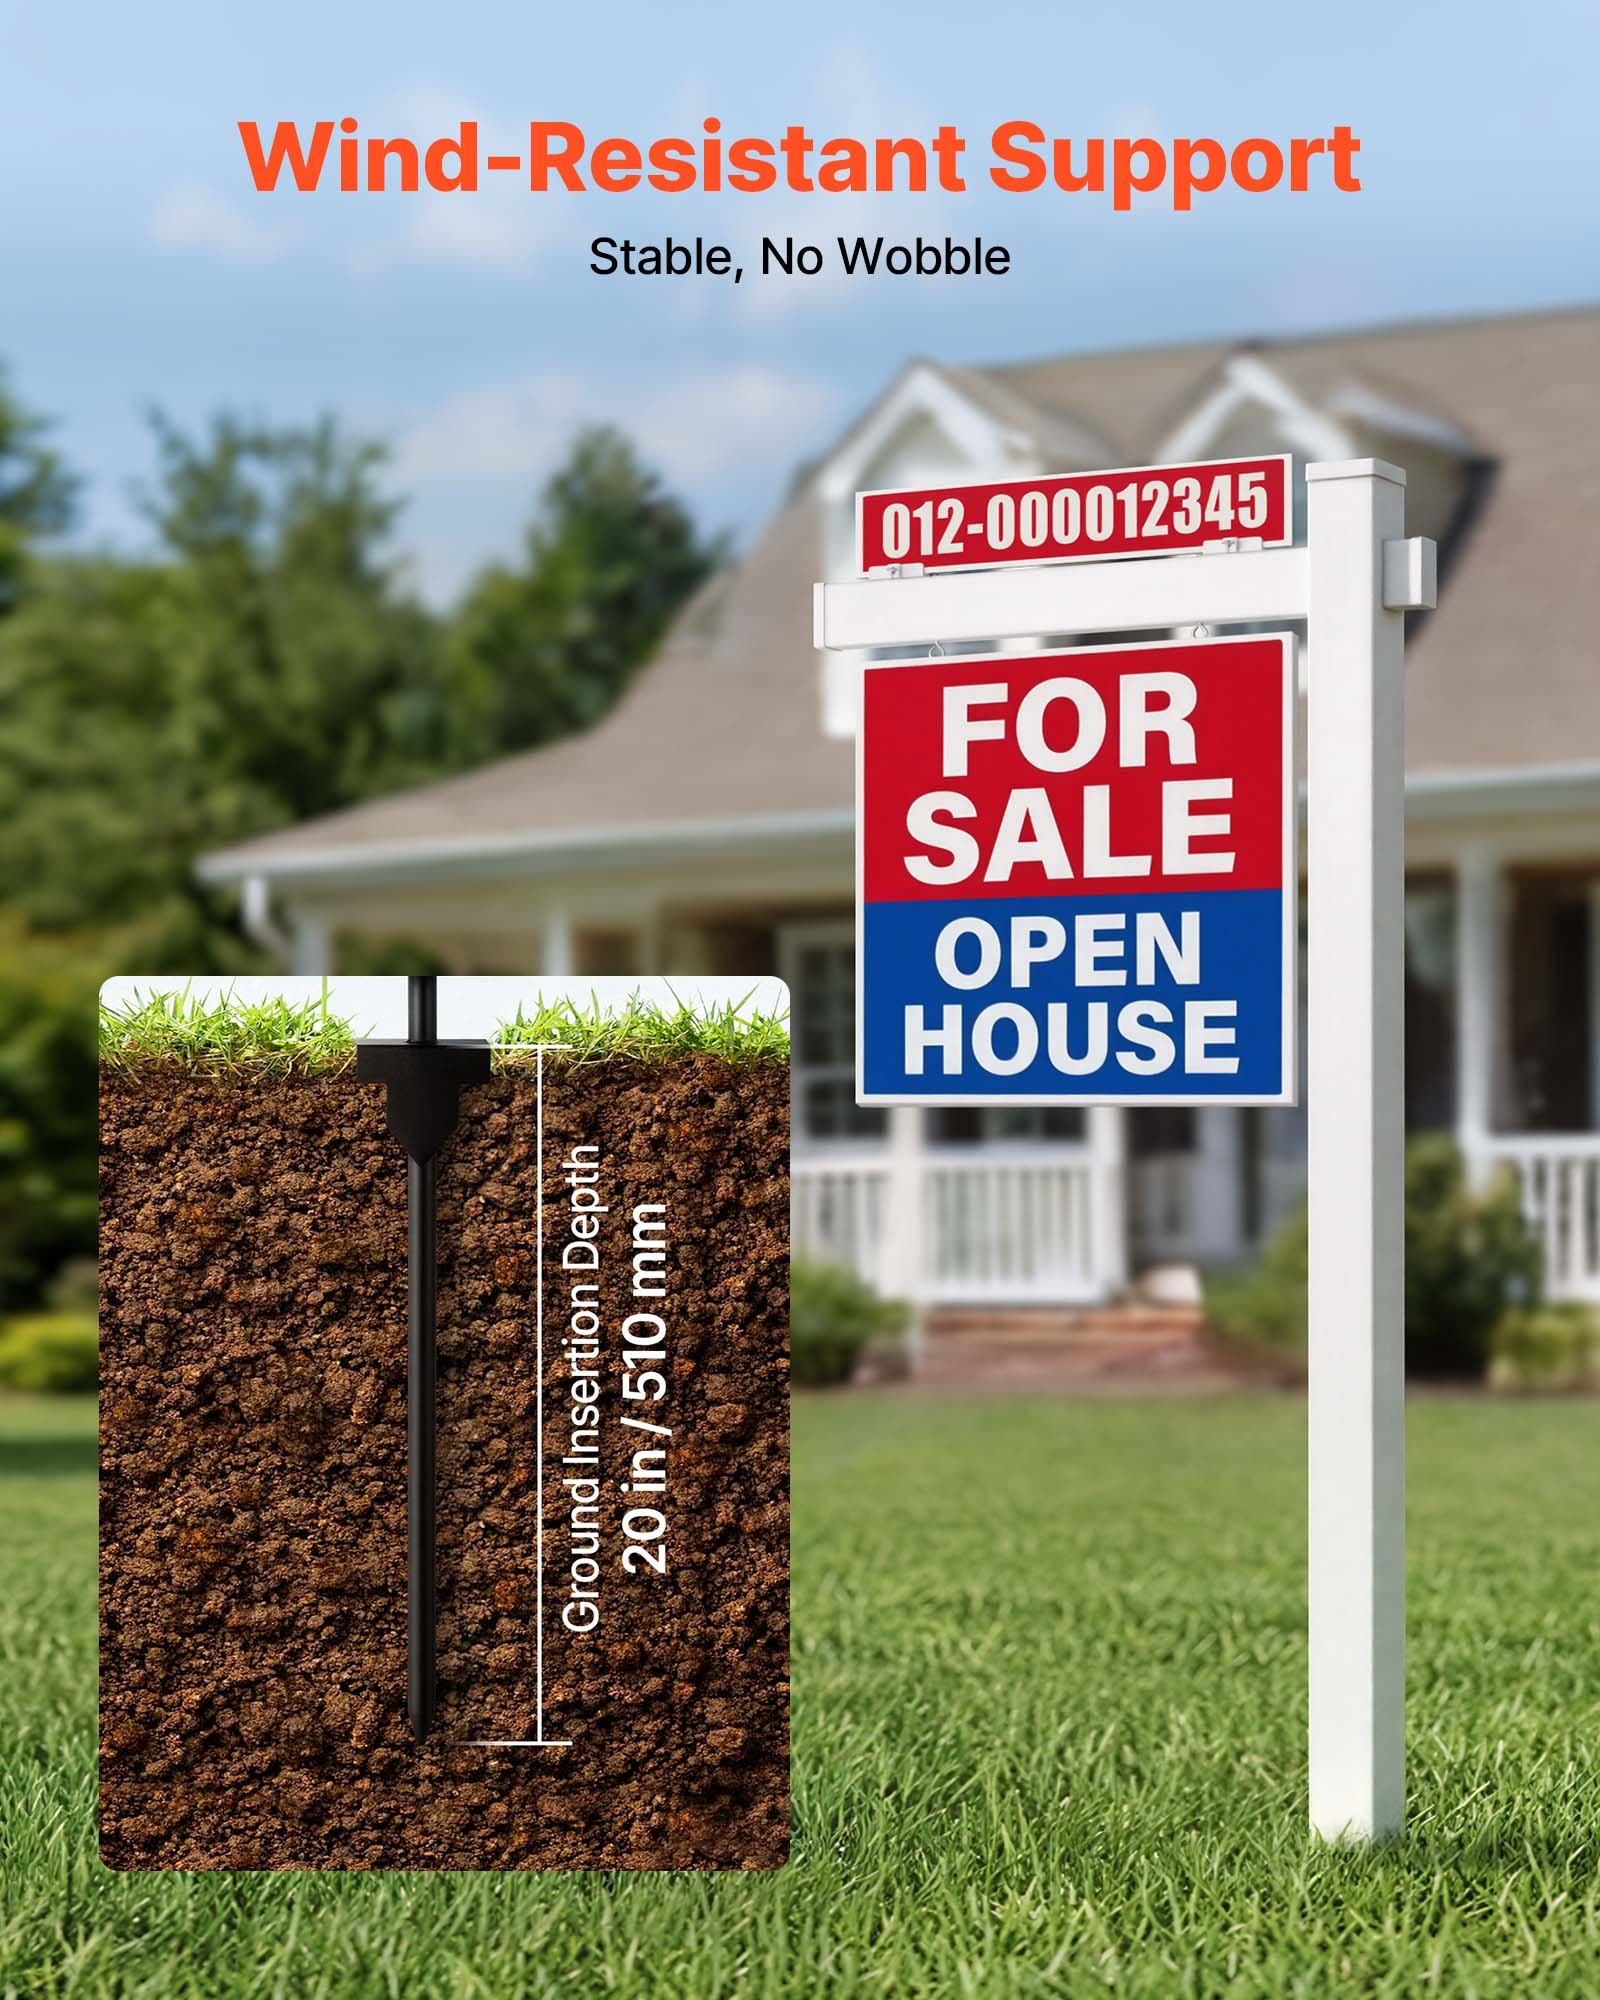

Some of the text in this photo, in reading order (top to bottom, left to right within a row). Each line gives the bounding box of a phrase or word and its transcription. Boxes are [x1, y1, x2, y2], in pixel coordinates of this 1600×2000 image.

[882, 471, 1268, 559] 012-000012345
[943, 672, 1197, 777] FOR
[904, 778, 1236, 885] SALE
[935, 912, 1200, 990] OPEN
[905, 1001, 1240, 1076] HOUSE
